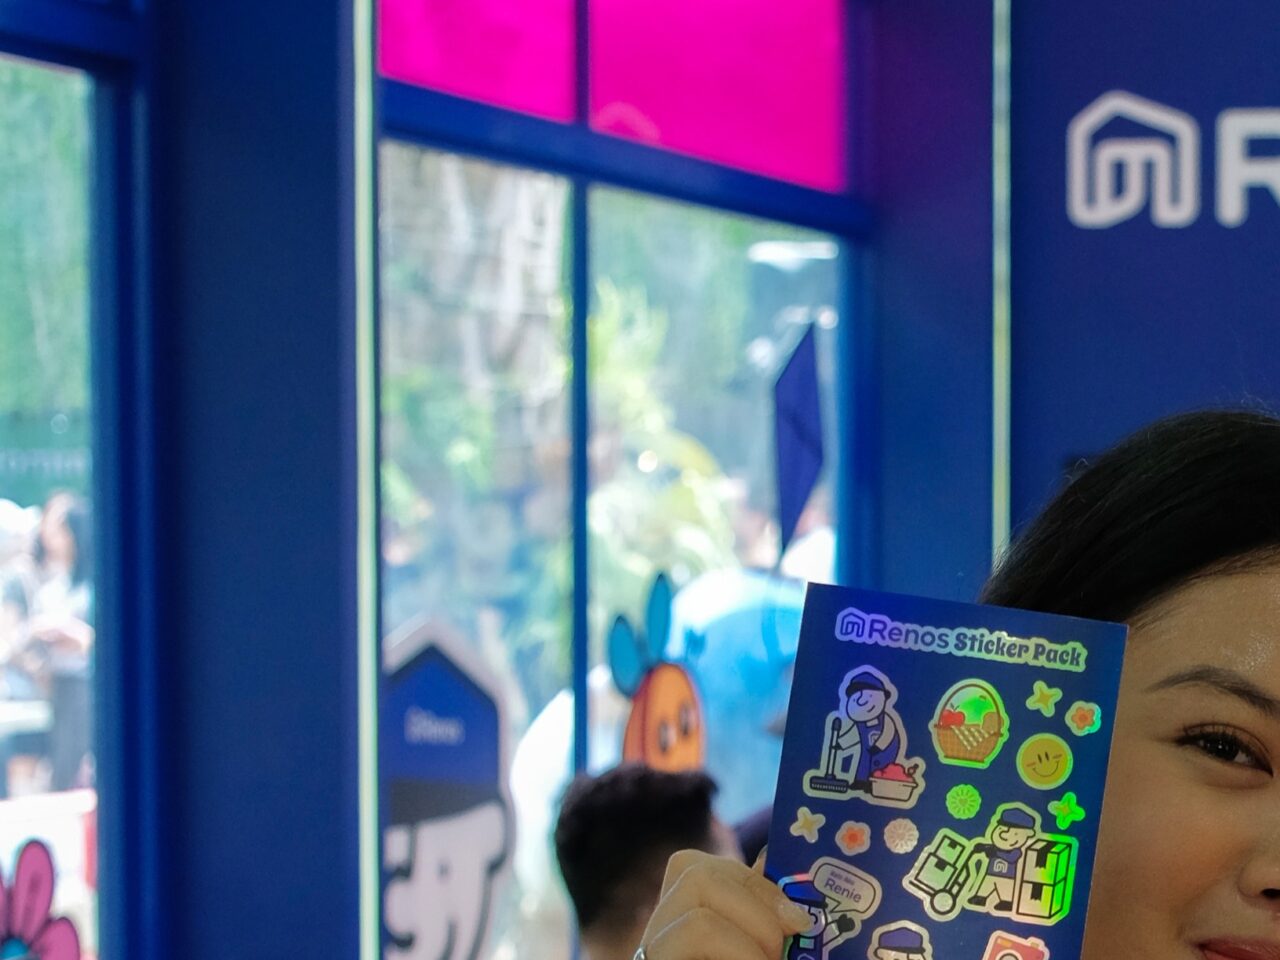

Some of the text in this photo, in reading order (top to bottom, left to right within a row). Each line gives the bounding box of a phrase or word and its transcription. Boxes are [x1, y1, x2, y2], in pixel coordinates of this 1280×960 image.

[868, 619, 1082, 667] Renos Sticker Pack
[824, 877, 862, 903] Renie
